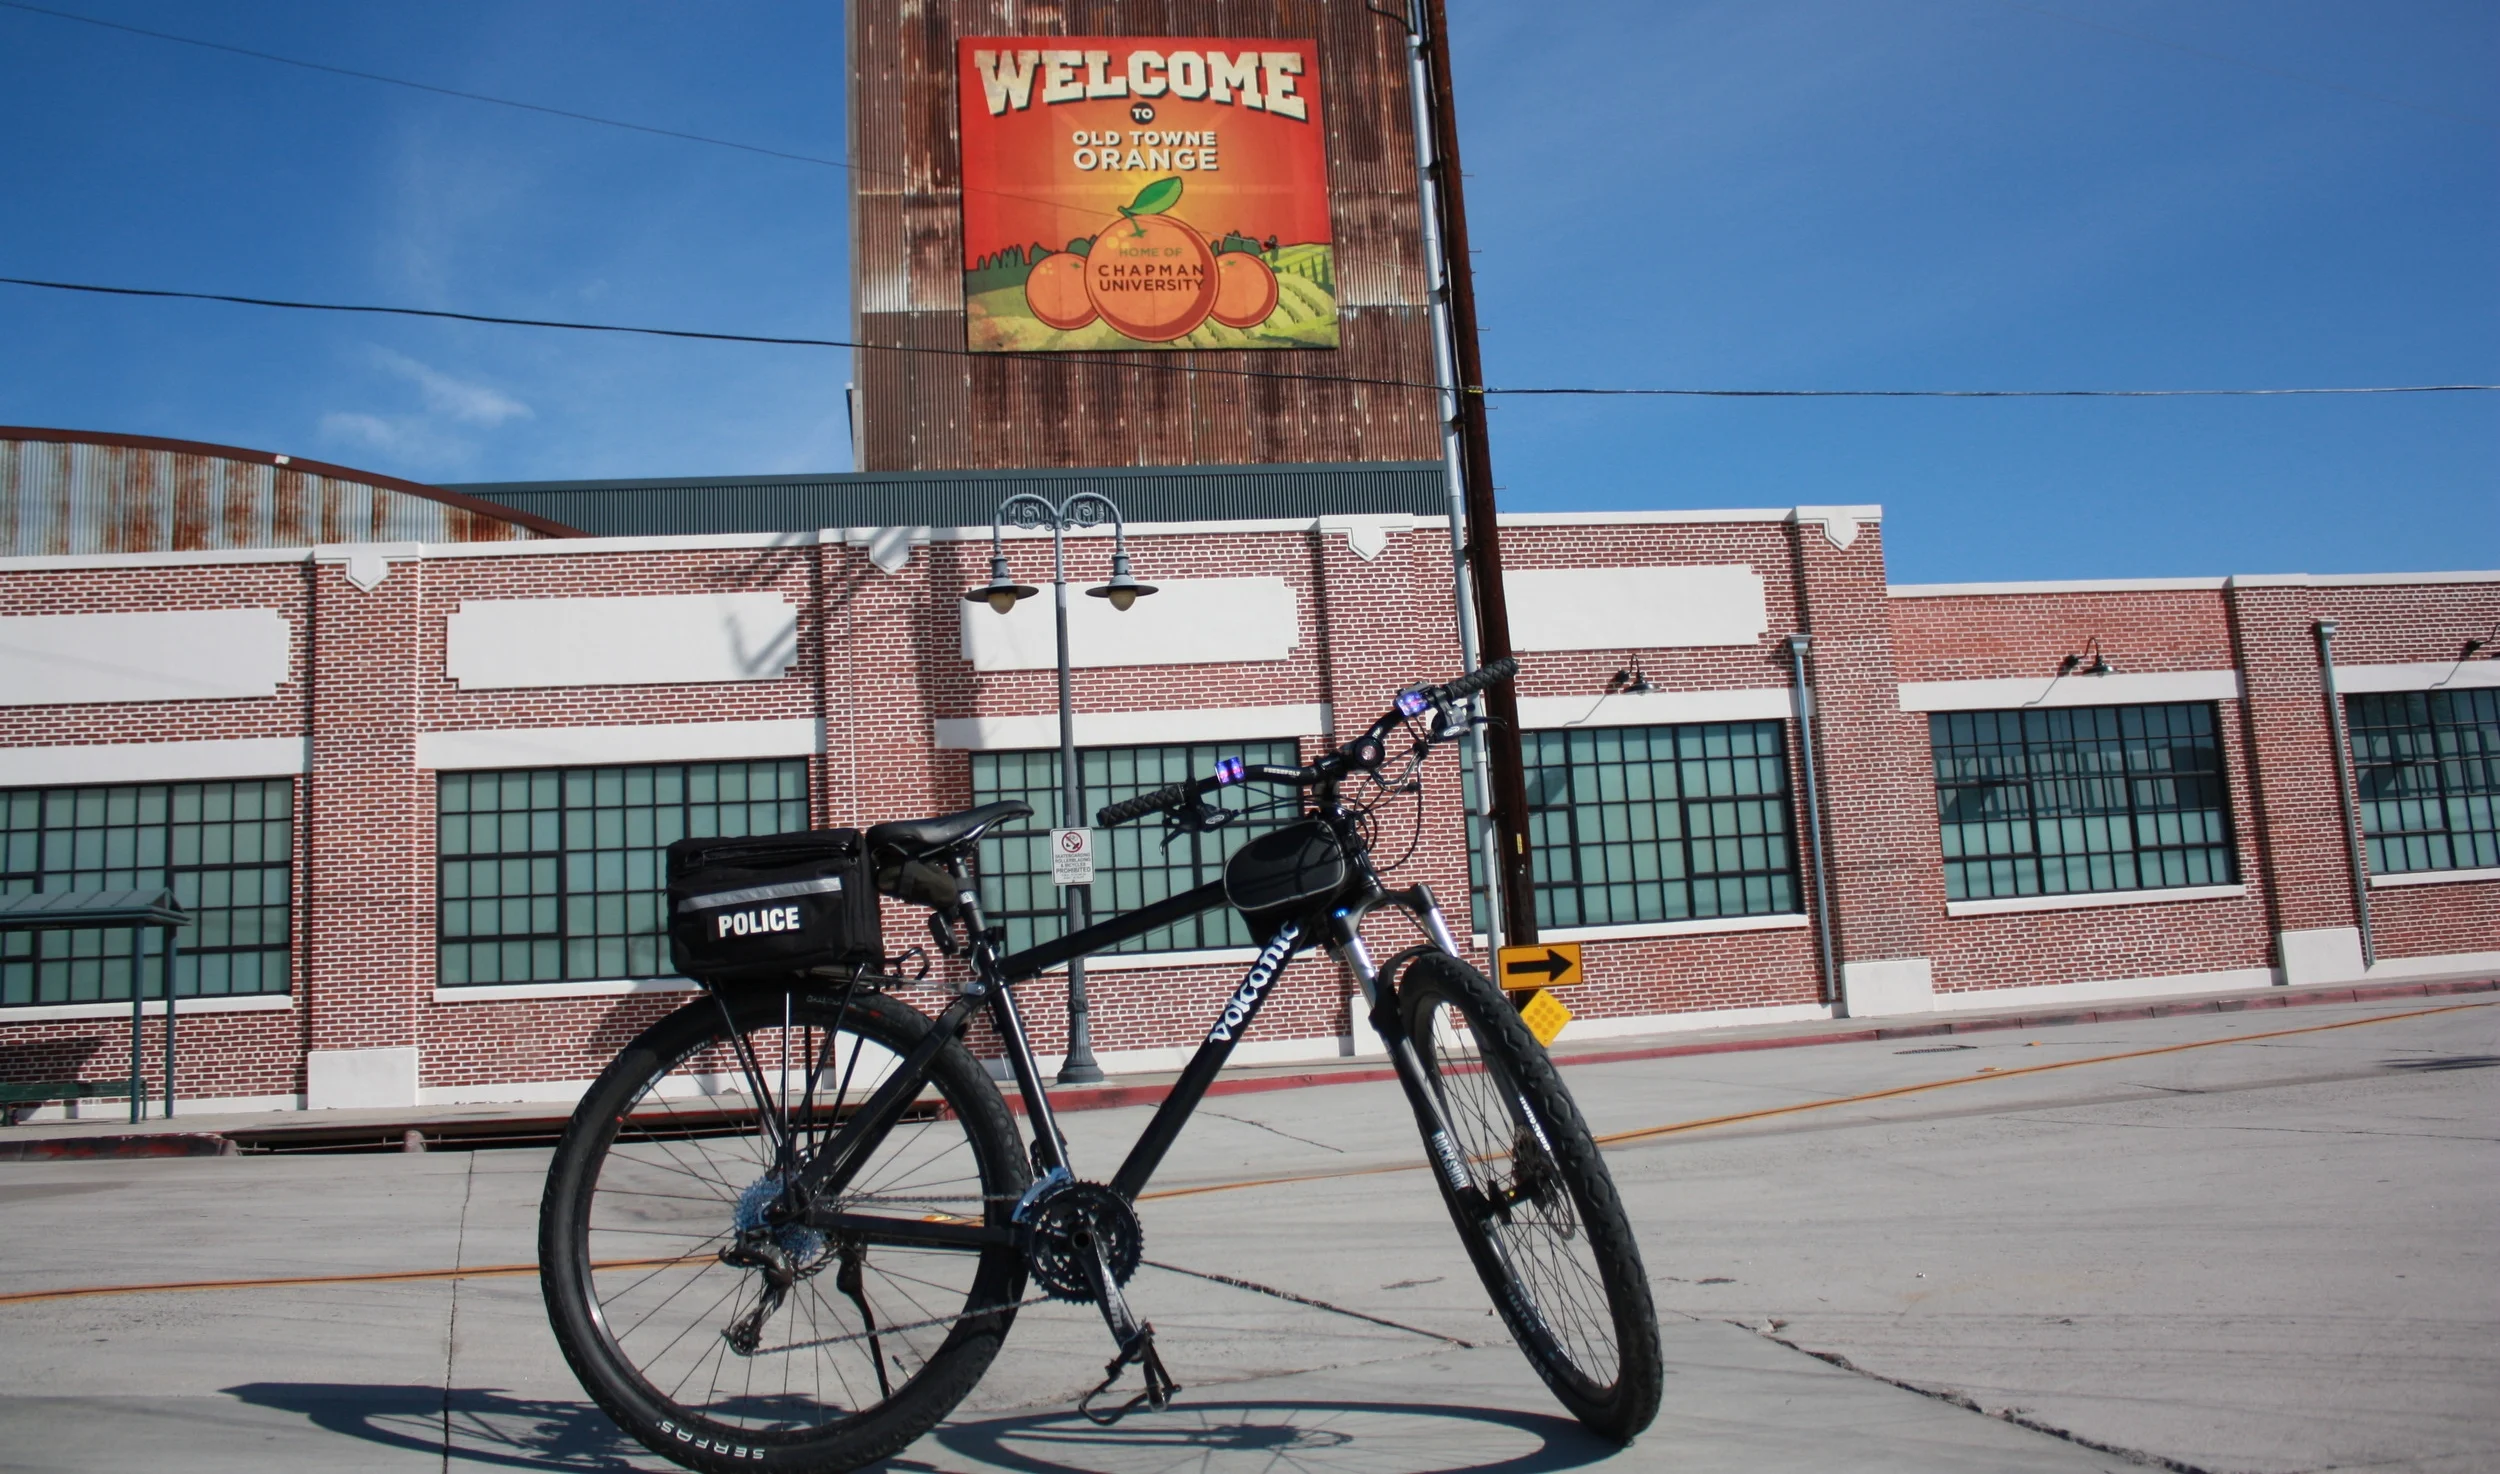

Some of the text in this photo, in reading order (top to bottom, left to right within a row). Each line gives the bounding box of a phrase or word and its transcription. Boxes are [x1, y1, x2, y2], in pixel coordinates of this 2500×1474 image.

[974, 50, 1307, 120] WELCOME
[1132, 107, 1154, 120] TO
[1072, 130, 1217, 147] OLD TOWNE
[1073, 148, 1219, 171] ORANGE
[1119, 247, 1183, 257] HOME OF
[1098, 264, 1204, 277] CHAPMAN
[1099, 279, 1205, 292] UNIVERSITY
[718, 906, 800, 938] POLICE
[660, 1420, 766, 1460] SERFAS
